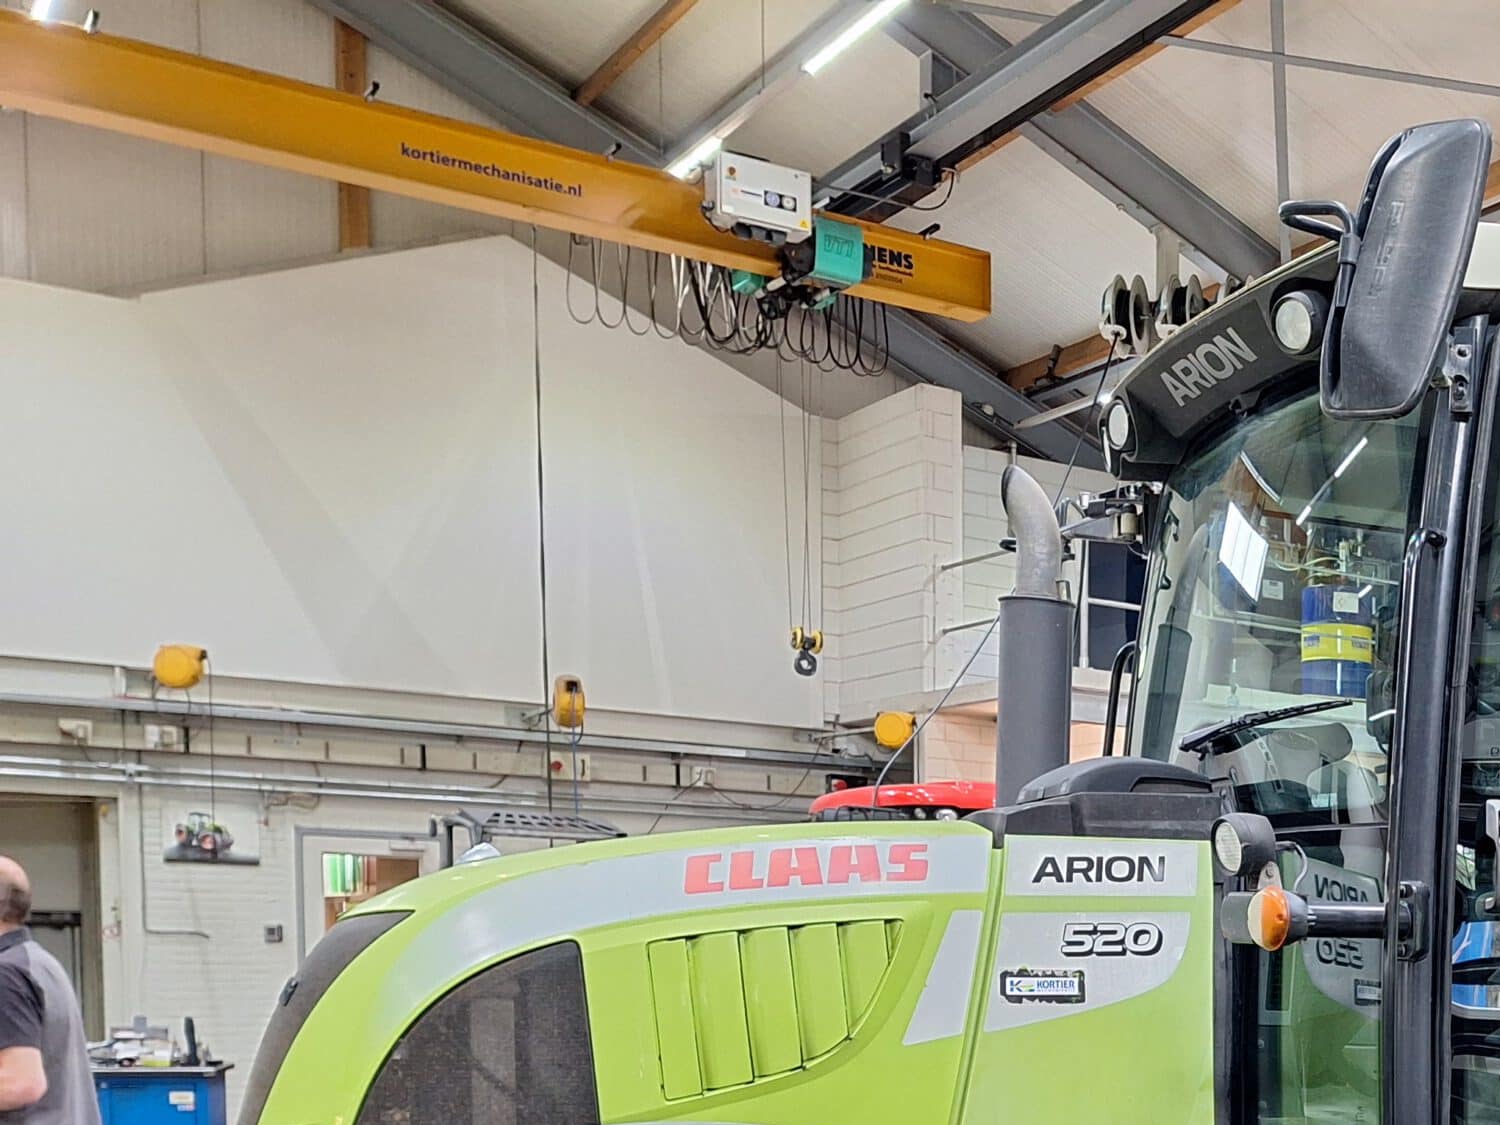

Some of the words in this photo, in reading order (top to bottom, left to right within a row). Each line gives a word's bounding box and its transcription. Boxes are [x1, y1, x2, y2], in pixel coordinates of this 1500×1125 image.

[400, 141, 583, 198] kortiermechanisatie.nl
[1159, 326, 1259, 408] ARION
[684, 844, 929, 894] CLAAS
[1031, 855, 1166, 884] ARION
[1060, 921, 1164, 957] 520
[1036, 978, 1075, 990] KORTIER
